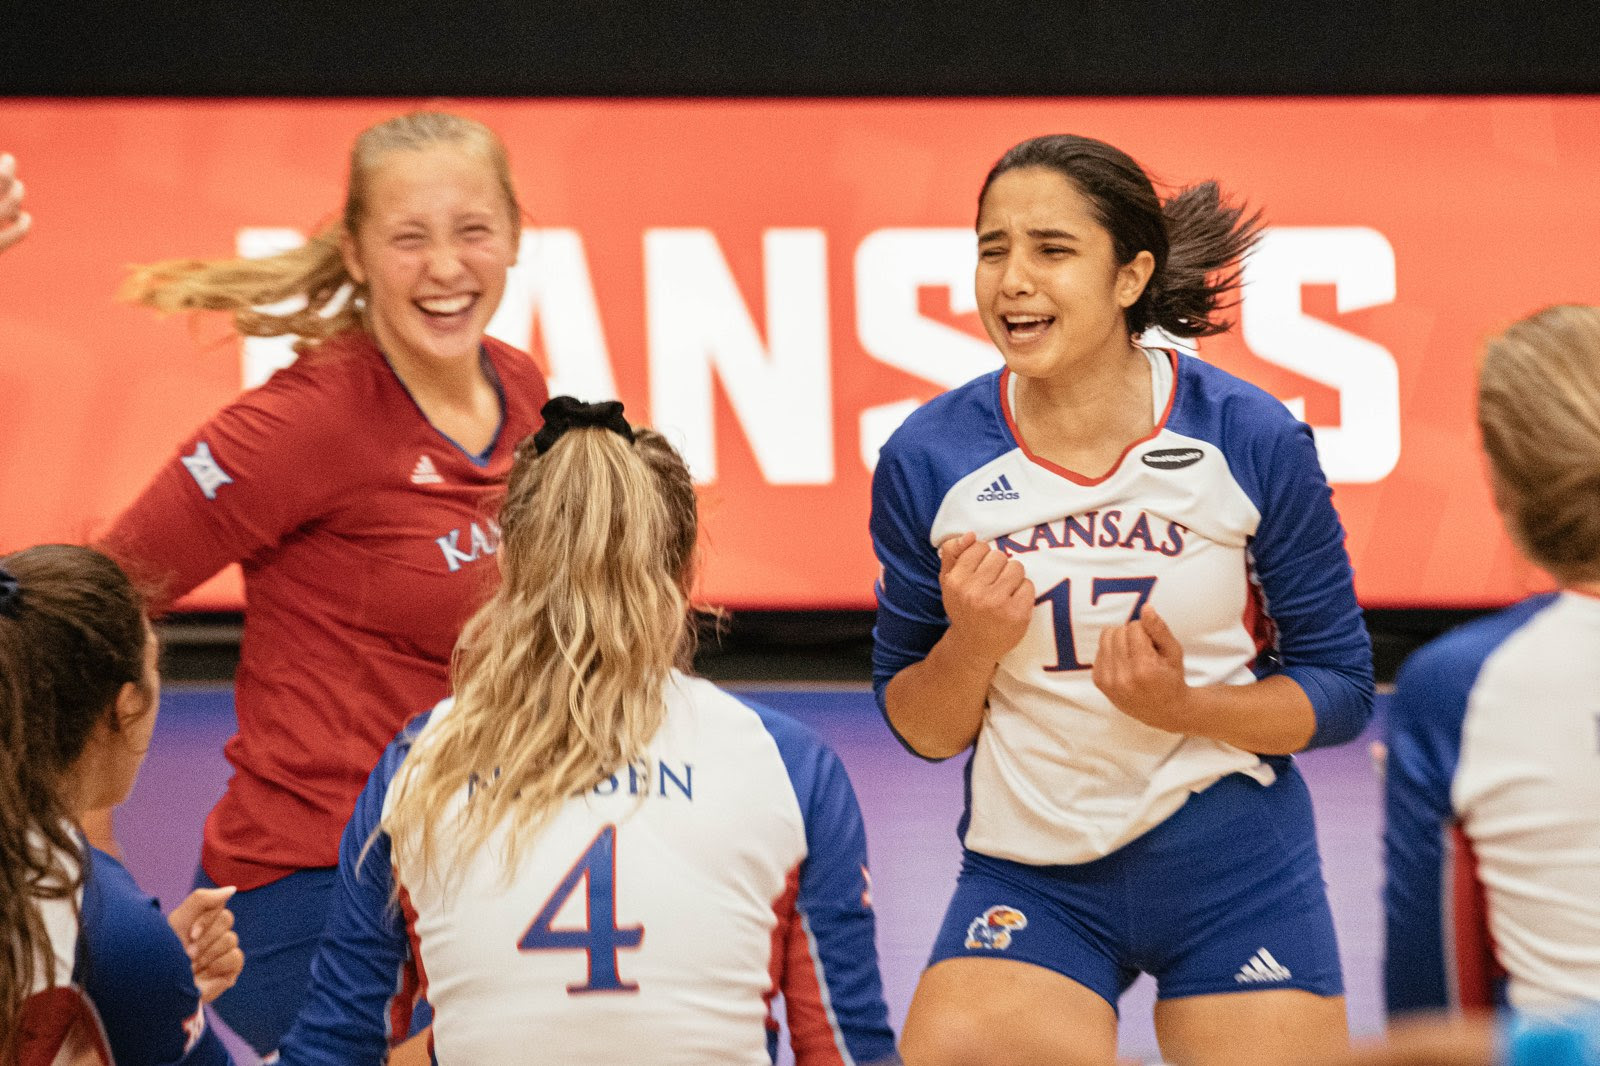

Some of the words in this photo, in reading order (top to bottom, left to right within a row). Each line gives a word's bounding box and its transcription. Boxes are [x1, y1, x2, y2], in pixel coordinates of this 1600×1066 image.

[977, 490, 1019, 501] adidas
[1034, 576, 1158, 672] 17
[517, 823, 645, 996] 4
